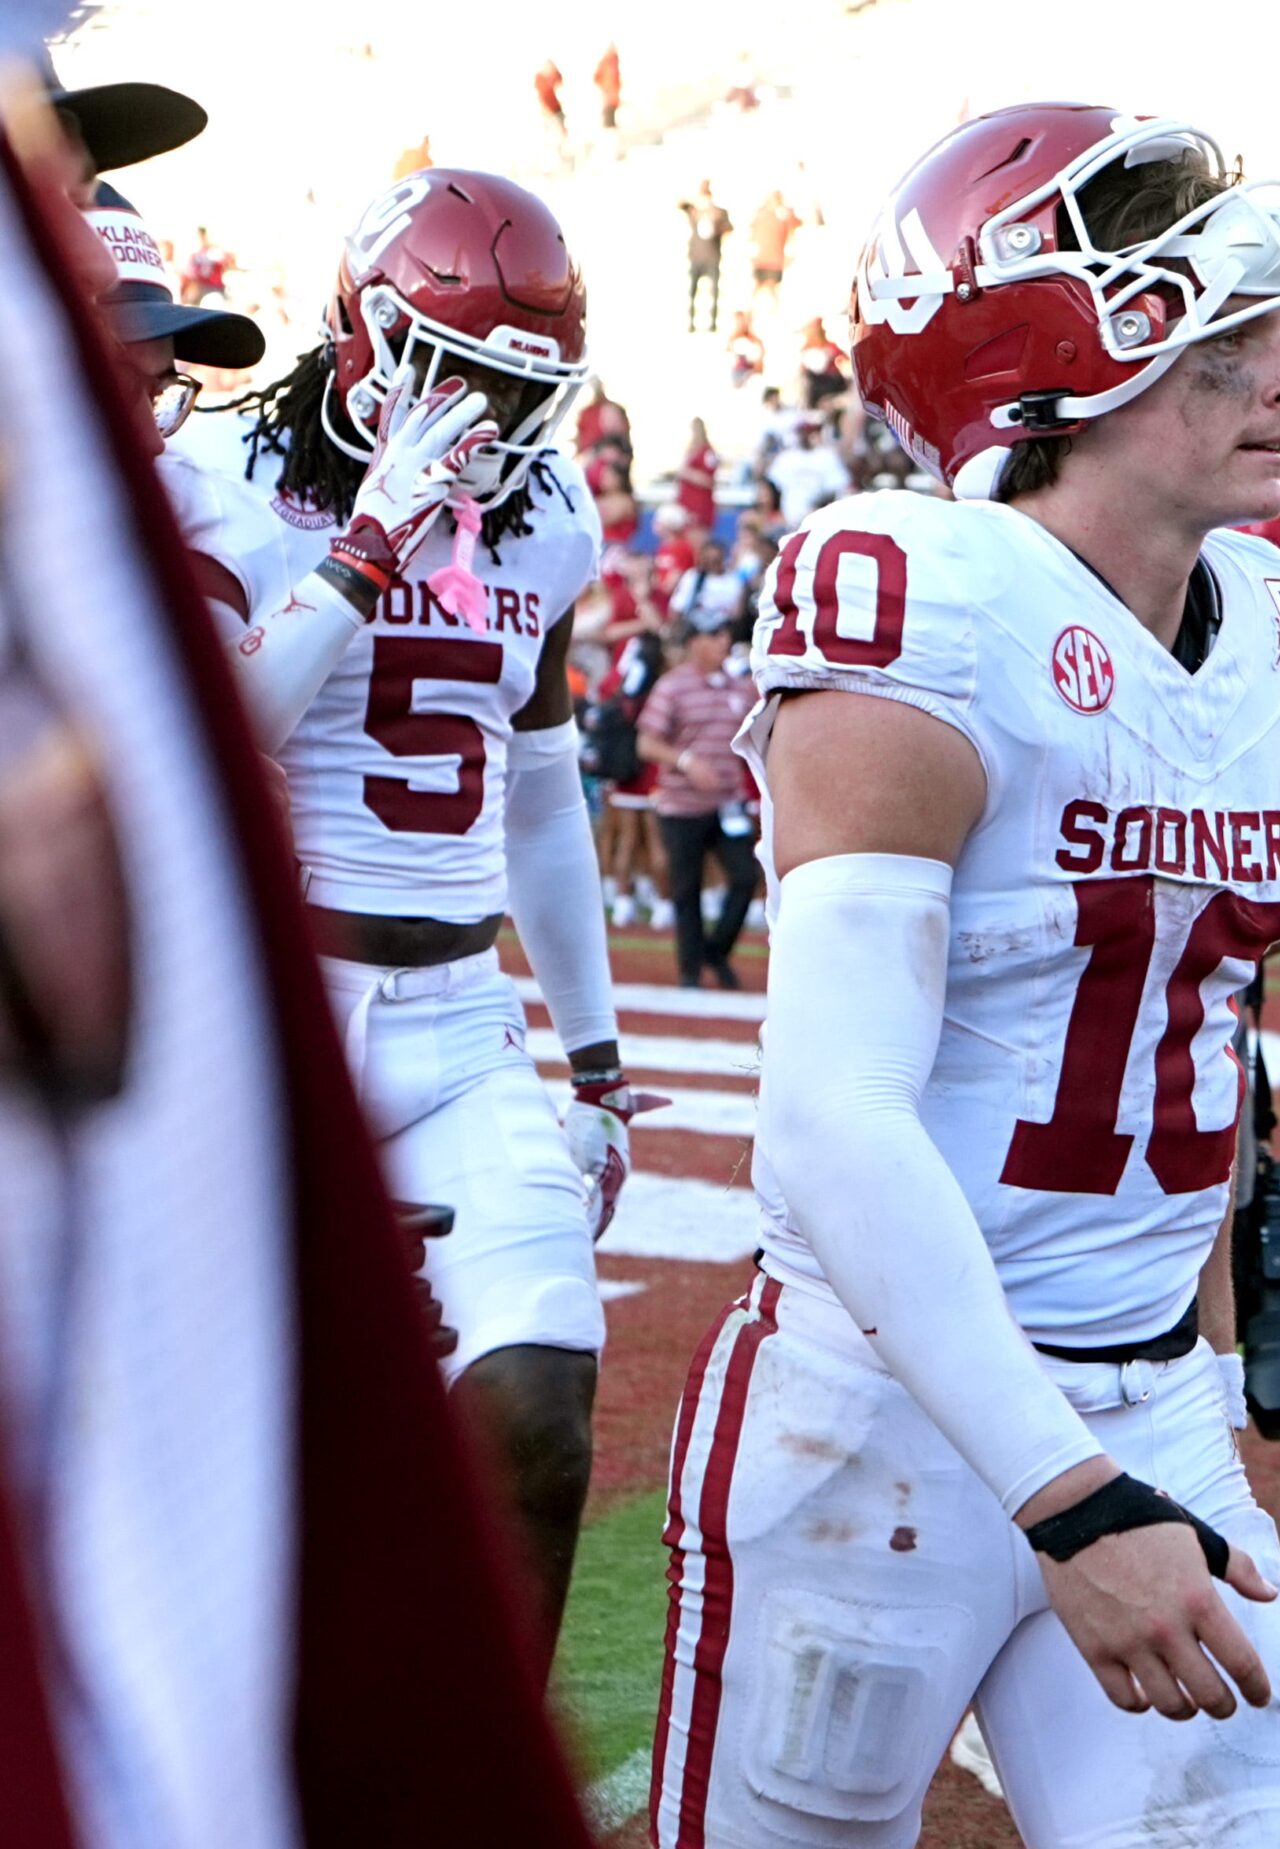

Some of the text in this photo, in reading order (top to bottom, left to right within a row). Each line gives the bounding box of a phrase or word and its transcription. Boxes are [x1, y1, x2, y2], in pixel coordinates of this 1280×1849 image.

[366, 578, 541, 638] ONRS
[767, 529, 908, 669] 10
[1053, 628, 1112, 708] SEC
[363, 635, 504, 835] 5
